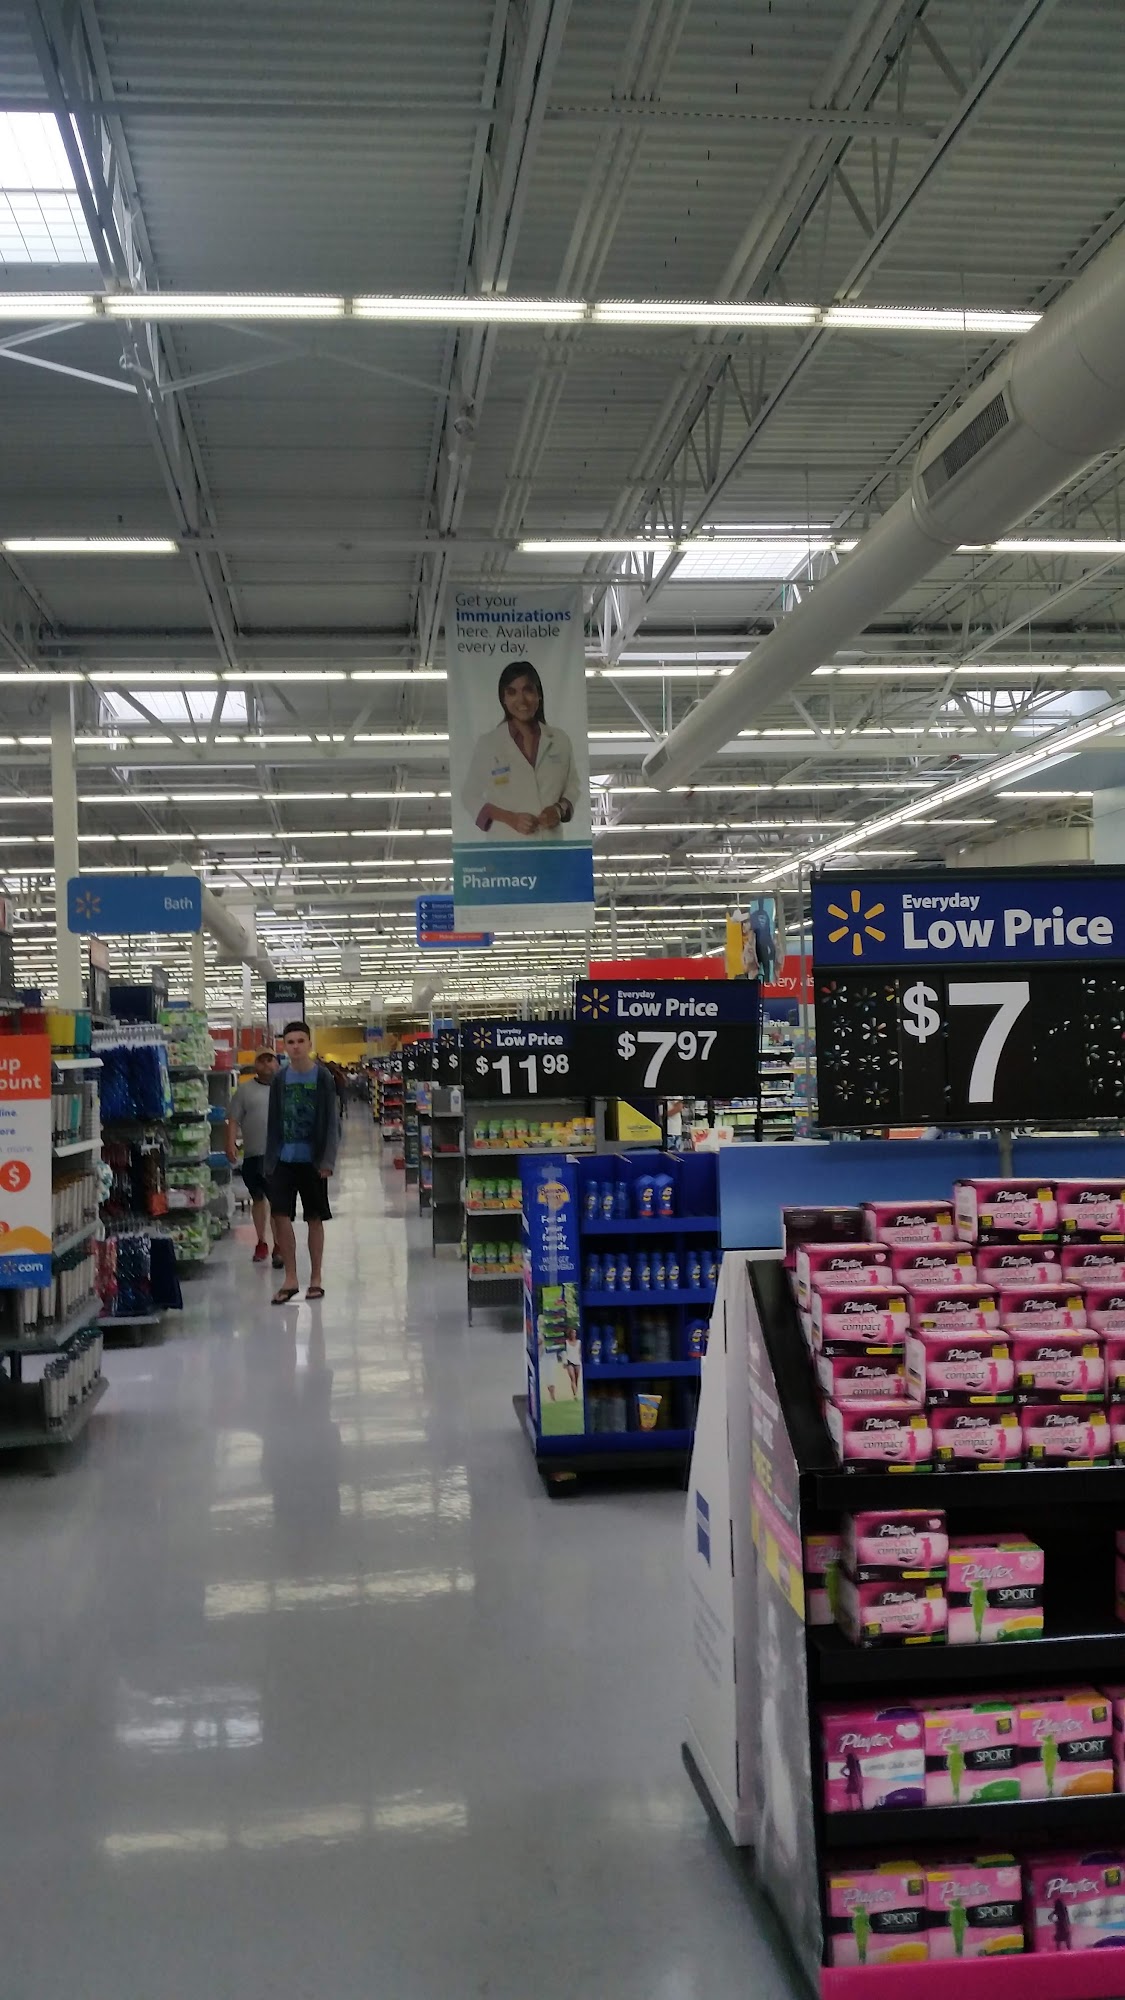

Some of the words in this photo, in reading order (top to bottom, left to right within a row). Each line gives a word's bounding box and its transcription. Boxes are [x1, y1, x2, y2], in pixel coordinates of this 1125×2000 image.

[455, 593, 481, 607] Get
[485, 595, 518, 609] your
[456, 608, 572, 623] immunizations
[457, 624, 492, 638] here.
[496, 624, 561, 638] Available
[457, 642, 496, 657] every
[500, 641, 529, 657] day.
[463, 874, 538, 890] Pharmacy
[163, 897, 194, 911] Bath
[902, 892, 980, 912] Everyday
[902, 912, 994, 949] Low
[1003, 906, 1115, 947] Price
[617, 989, 656, 1001] Everyday
[617, 998, 663, 1018] Low
[665, 997, 719, 1017] Price
[496, 1033, 527, 1047] Low
[528, 1032, 564, 1046] Price
[996, 1190, 1029, 1203] Playtex
[1079, 1191, 1111, 1204] Playtex
[896, 1215, 927, 1227] Playtex
[830, 1258, 864, 1271] Playtex
[914, 1257, 948, 1269] Playtex
[1000, 1255, 1034, 1268] Playtex
[1083, 1254, 1116, 1267] Playtex
[843, 1301, 878, 1314] Playtex
[936, 1300, 971, 1314] Playtex
[1023, 1300, 1058, 1313] Playtex
[842, 1322, 881, 1334] compact
[946, 1349, 982, 1362] Playtex
[1037, 1348, 1073, 1362] Playtex
[854, 1366, 889, 1379] Playtex
[945, 1370, 985, 1381] compact
[1034, 1370, 1076, 1381] compact
[864, 1417, 900, 1431] Playtex
[955, 1415, 991, 1430] Playtex
[1045, 1414, 1080, 1428] Playtex
[863, 1440, 904, 1451] compact
[879, 1524, 917, 1537] Playtex
[961, 1563, 1014, 1583] Playtex
[883, 1591, 917, 1605] Playtex
[998, 1587, 1036, 1600] SPORT
[840, 1732, 894, 1754] Playtex
[1069, 1740, 1105, 1756] SPORT
[975, 1748, 1014, 1763] SPORT
[1046, 1877, 1101, 1899] Playtex
[881, 1911, 919, 1927] SPORT
[977, 1904, 1015, 1920] SPORT
